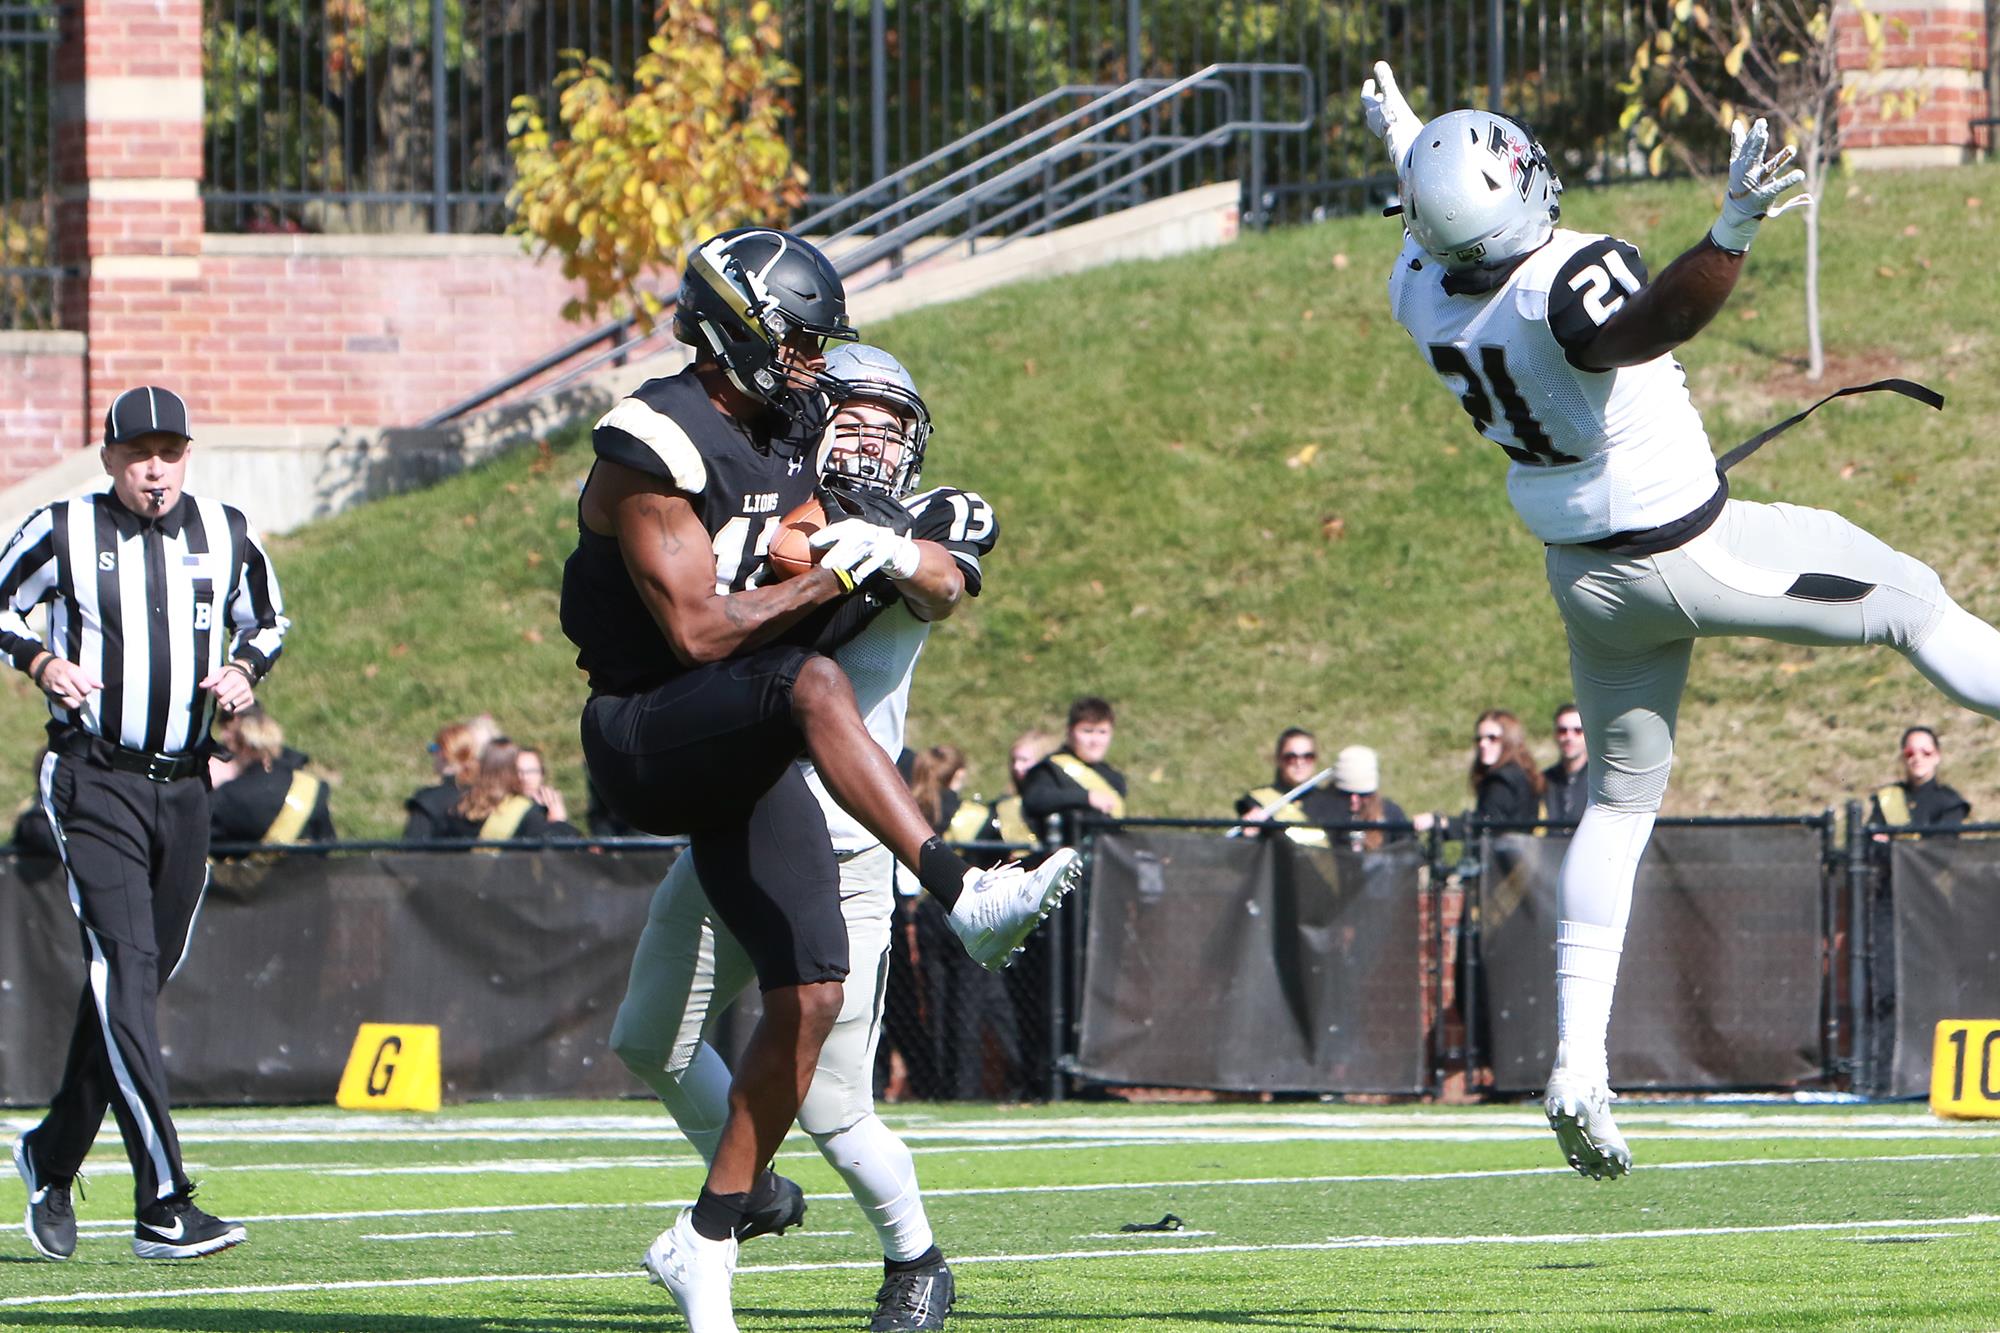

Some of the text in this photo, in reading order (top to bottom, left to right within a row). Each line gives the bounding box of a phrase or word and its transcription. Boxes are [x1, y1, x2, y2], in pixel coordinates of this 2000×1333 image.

[1568, 249, 1641, 327] 21
[1428, 343, 1584, 467] 21
[742, 492, 779, 513] LIONS
[945, 492, 994, 541] 13
[98, 551, 115, 571] S
[194, 602, 212, 630] B
[367, 1035, 401, 1096] G
